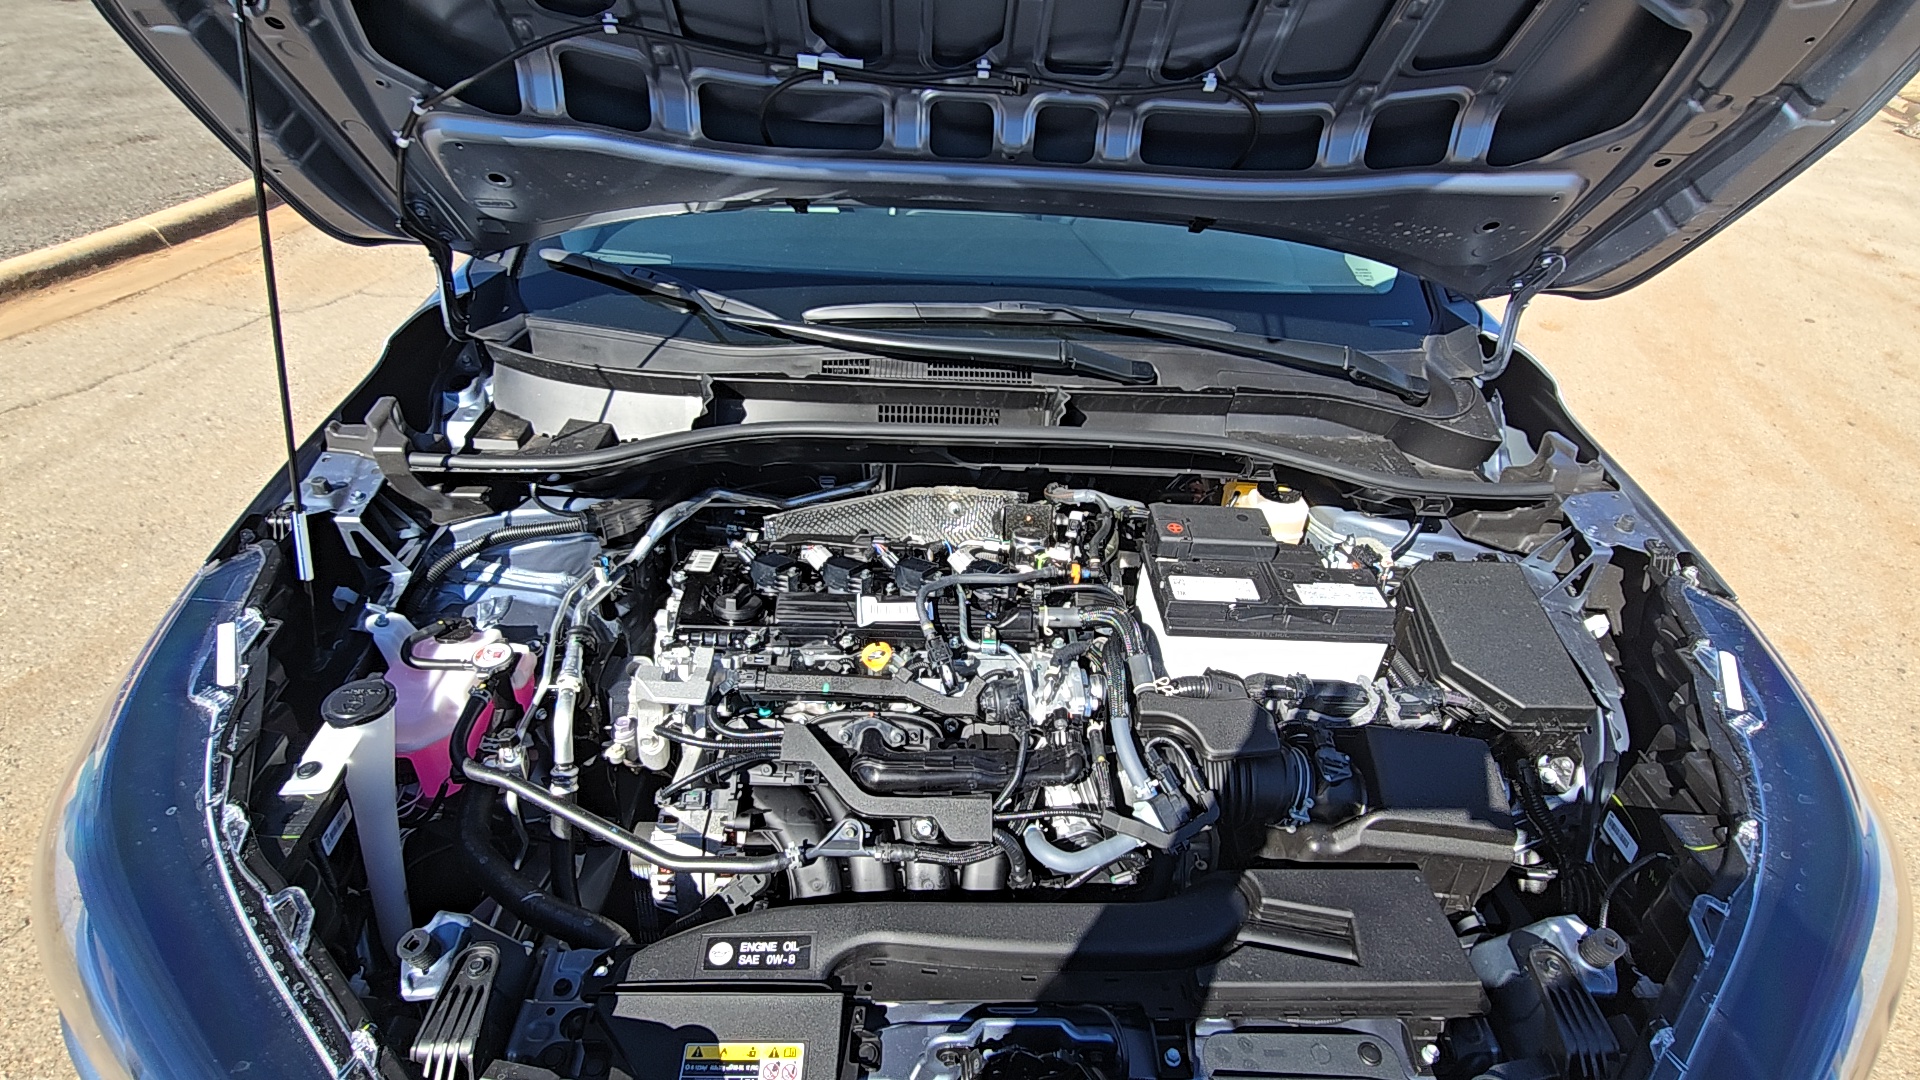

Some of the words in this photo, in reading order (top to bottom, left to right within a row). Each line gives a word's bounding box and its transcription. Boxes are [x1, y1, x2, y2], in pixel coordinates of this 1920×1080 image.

[740, 941, 778, 953] ENGINE
[782, 940, 800, 952] OIL
[738, 954, 760, 965] SAE
